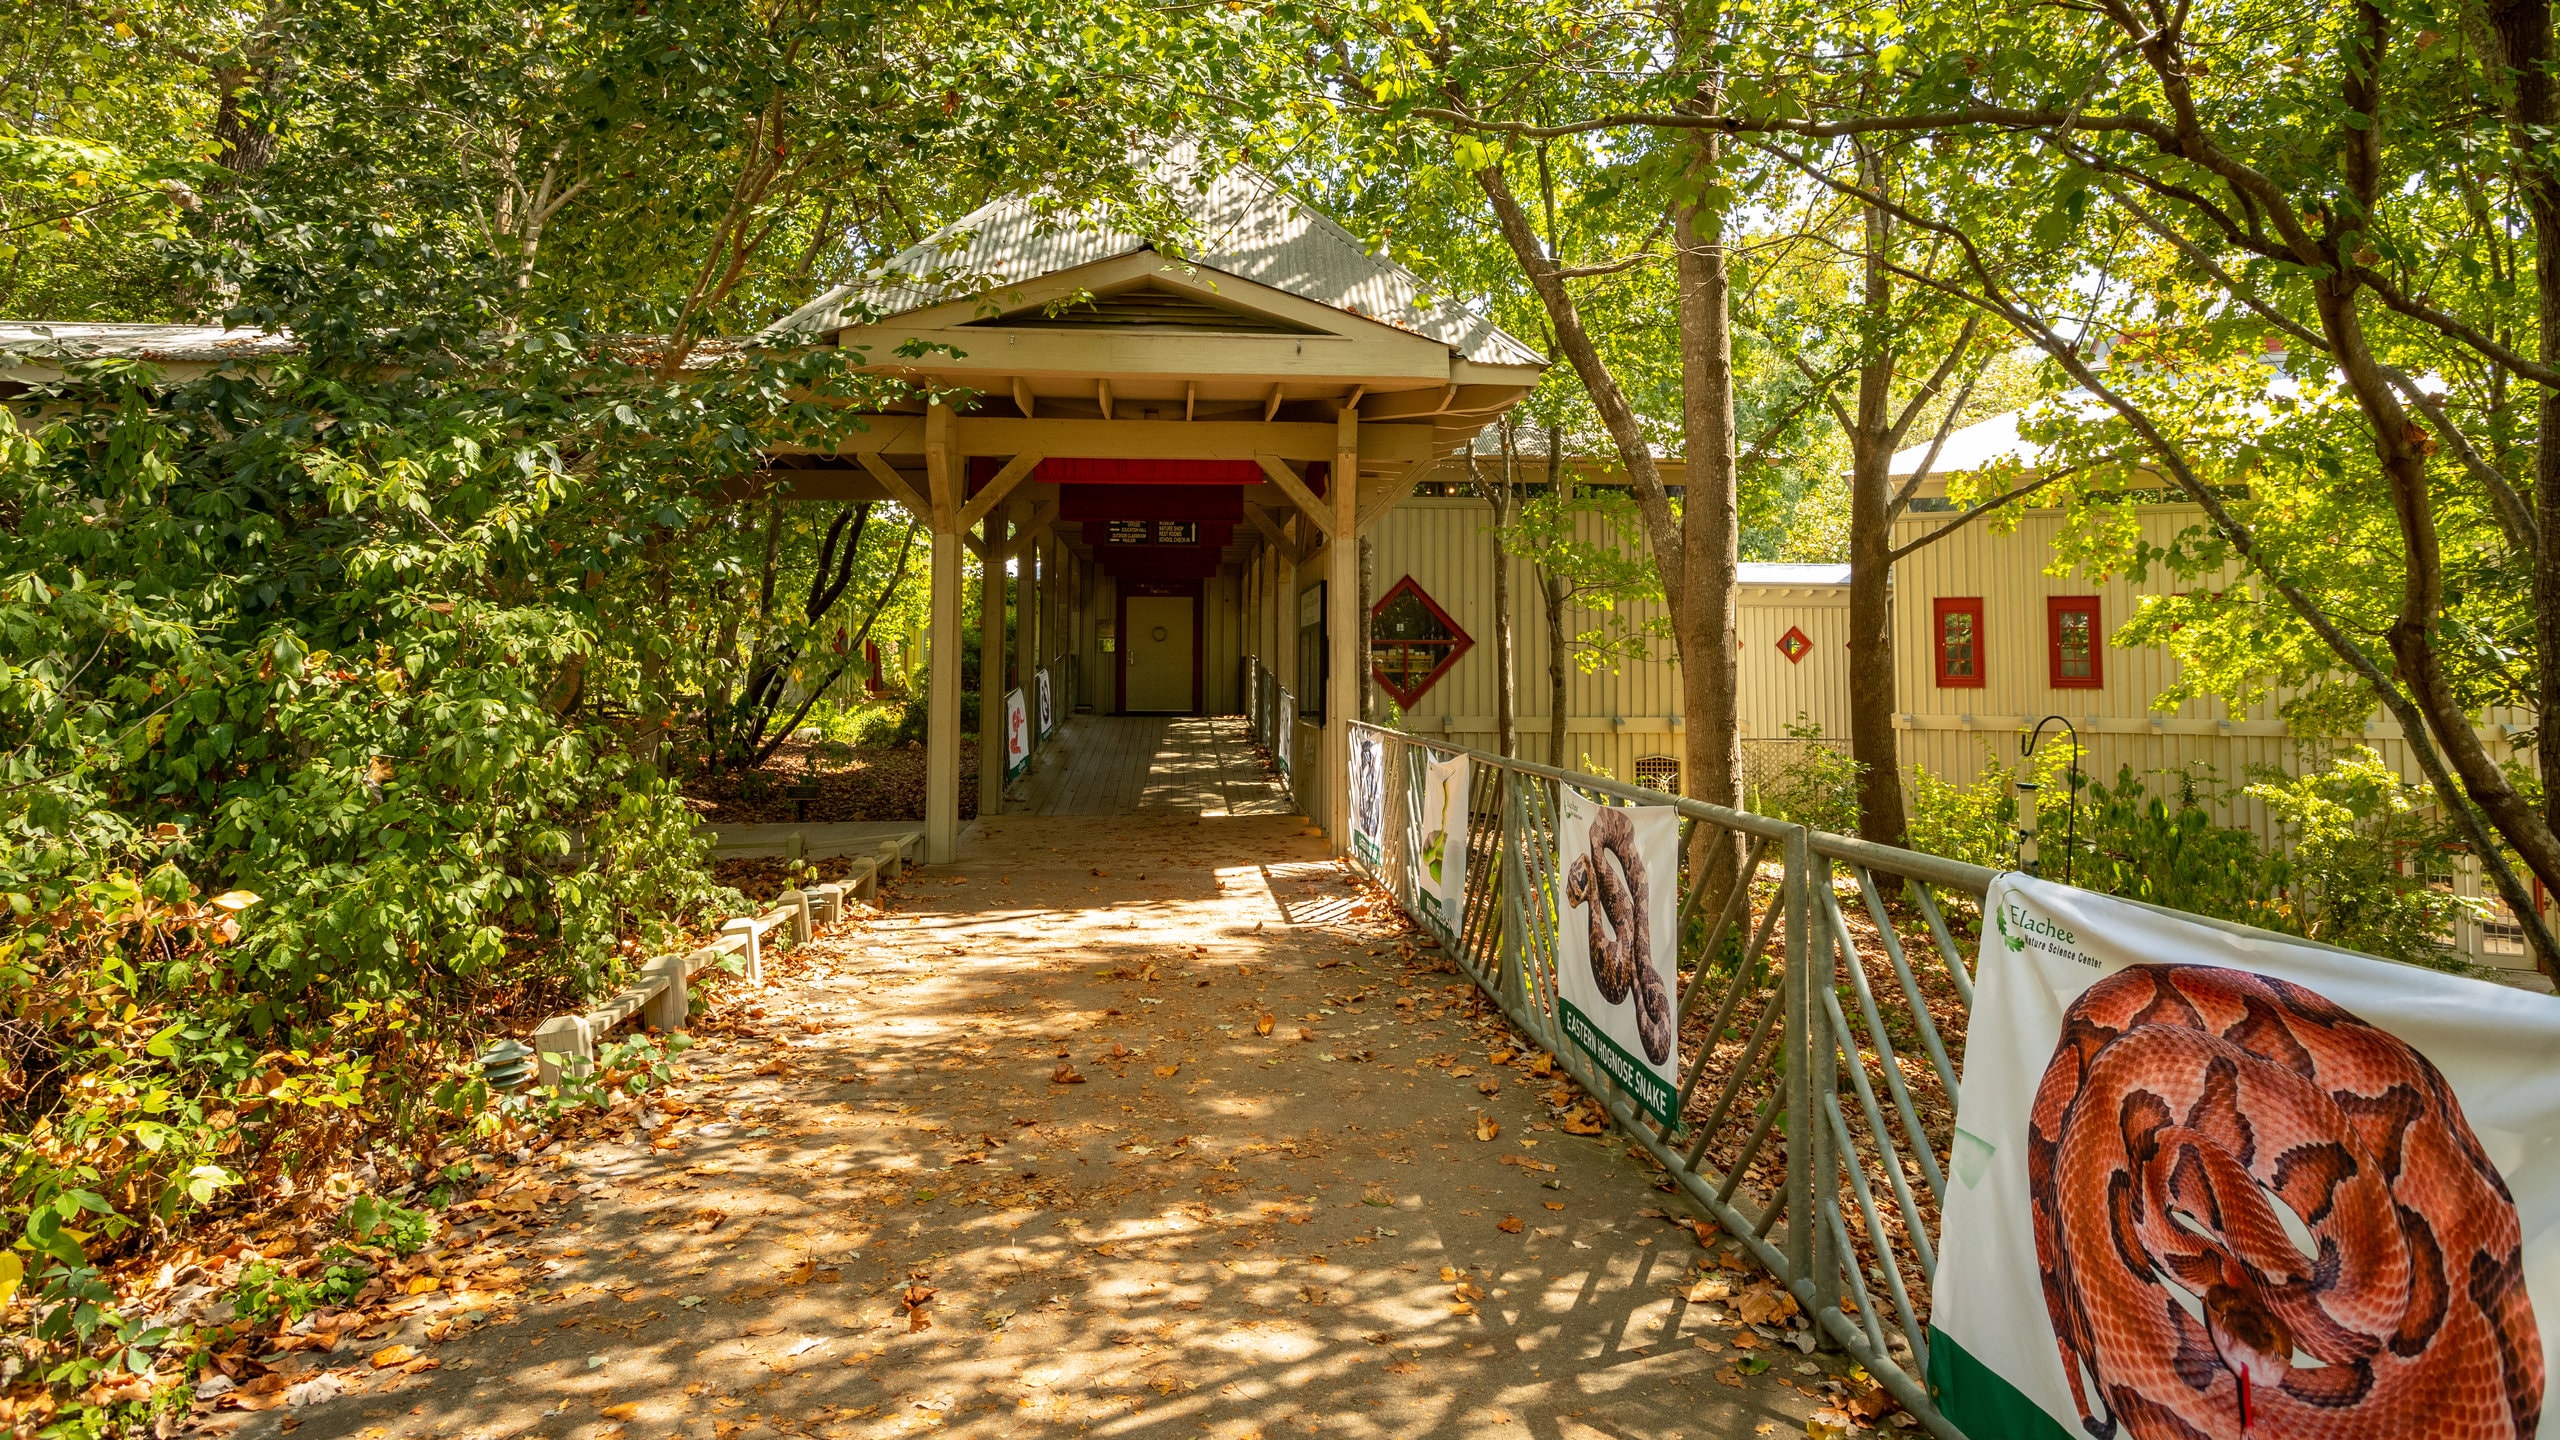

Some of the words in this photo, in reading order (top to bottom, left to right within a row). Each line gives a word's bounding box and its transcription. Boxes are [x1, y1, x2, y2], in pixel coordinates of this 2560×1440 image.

[2009, 904, 2076, 945] Elachee
[2024, 934, 2046, 951] Nature
[2048, 942, 2076, 960] Science
[2078, 952, 2102, 969] Center
[1567, 1011, 1597, 1055] EASTERN
[1597, 1040, 1634, 1089] HOGNOSE
[1634, 1071, 1667, 1117] SNAKE
